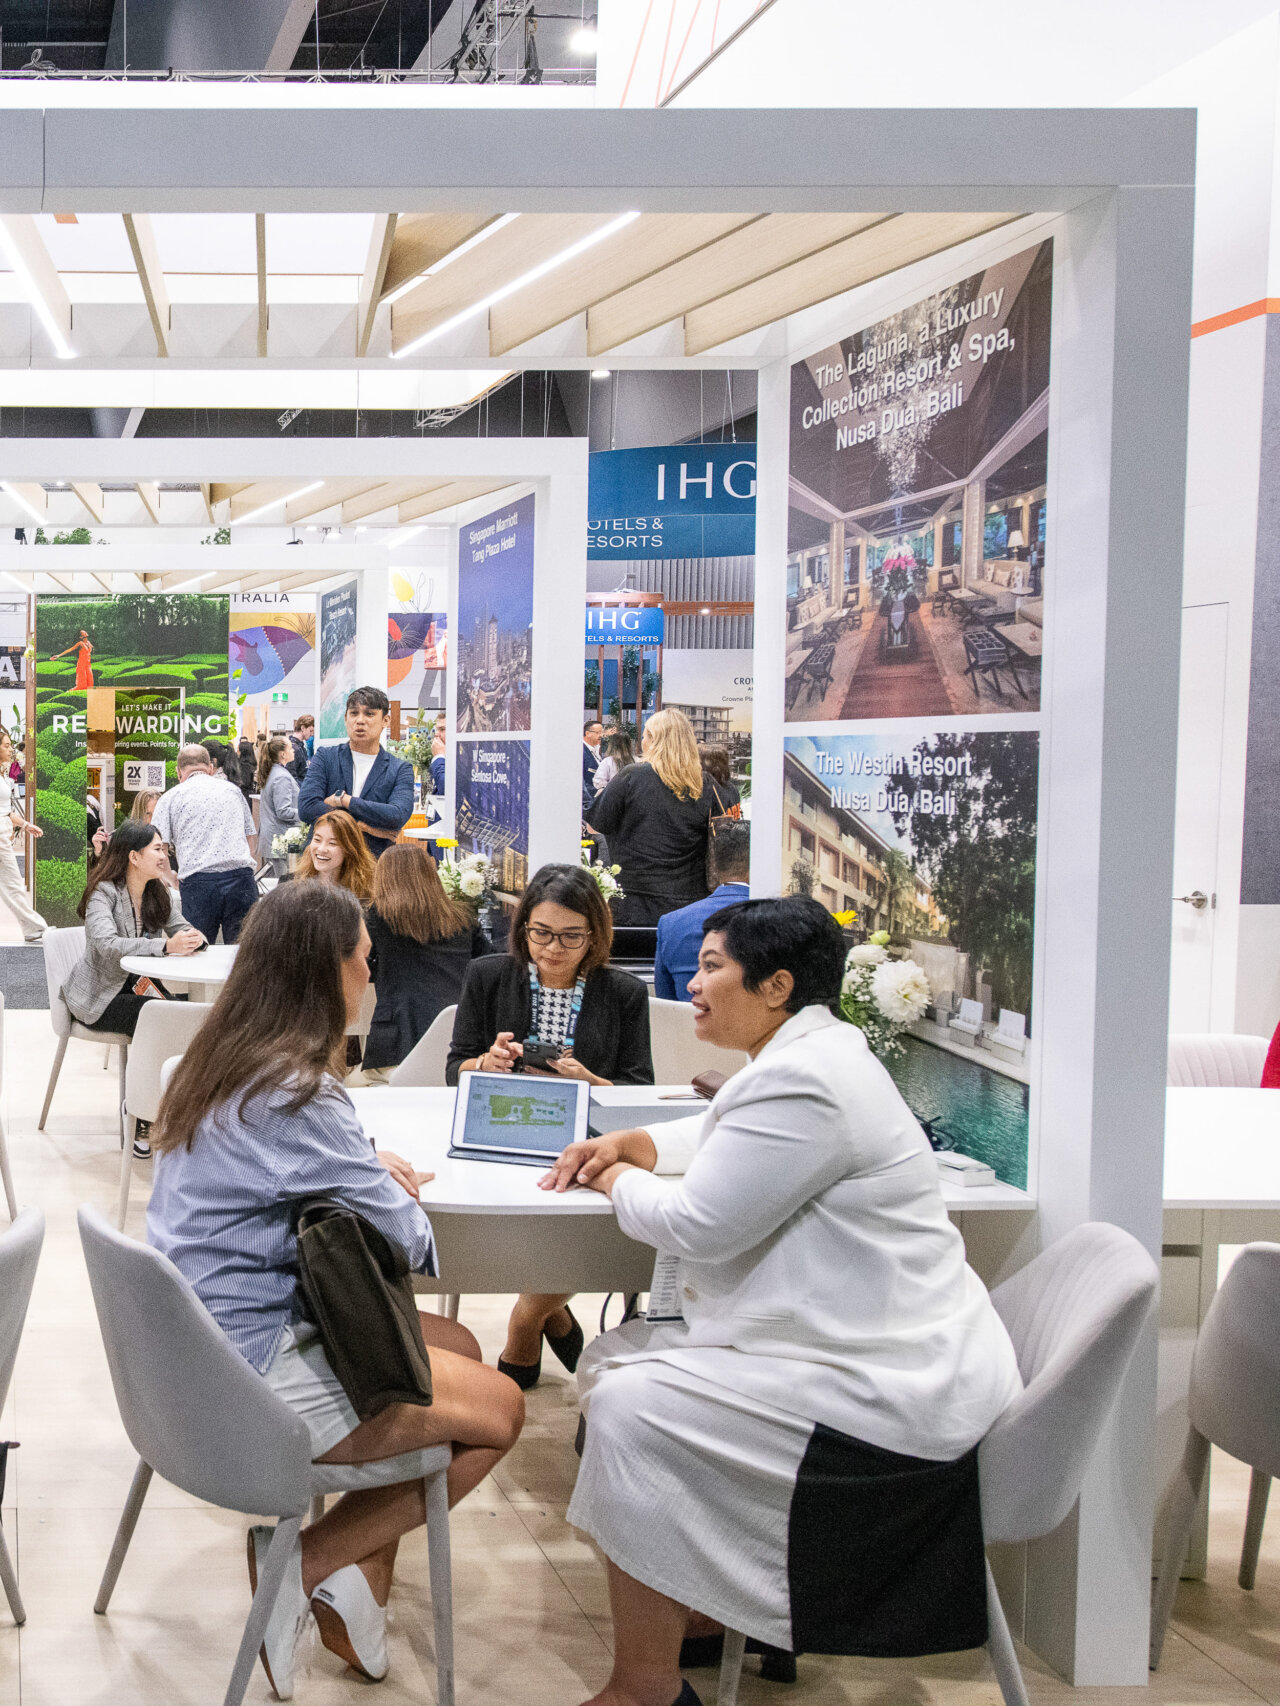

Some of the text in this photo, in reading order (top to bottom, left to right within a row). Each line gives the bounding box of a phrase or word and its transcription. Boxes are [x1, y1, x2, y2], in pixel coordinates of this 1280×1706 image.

[816, 288, 1005, 389] The Laguna, a Luxury
[802, 327, 1016, 430] Collection Resort & Spa,
[836, 381, 963, 451] Nusa Dua, Bali
[657, 460, 757, 501] IHG
[469, 512, 518, 545] Singapore Marriott
[651, 517, 664, 530] &
[472, 532, 516, 563] Tang Plaza Hotel
[588, 610, 640, 631] IHG
[615, 635, 659, 643] RESORTS
[121, 704, 140, 712] LET'S
[164, 703, 172, 711] IT
[150, 740, 167, 748] Points
[168, 740, 177, 748] for
[479, 749, 506, 766] Singapore
[816, 751, 972, 777] The Westin Resort
[127, 766, 142, 779] 2X
[471, 768, 492, 783] Sentosa
[830, 786, 870, 811] Nusa
[920, 789, 956, 815] Bali
